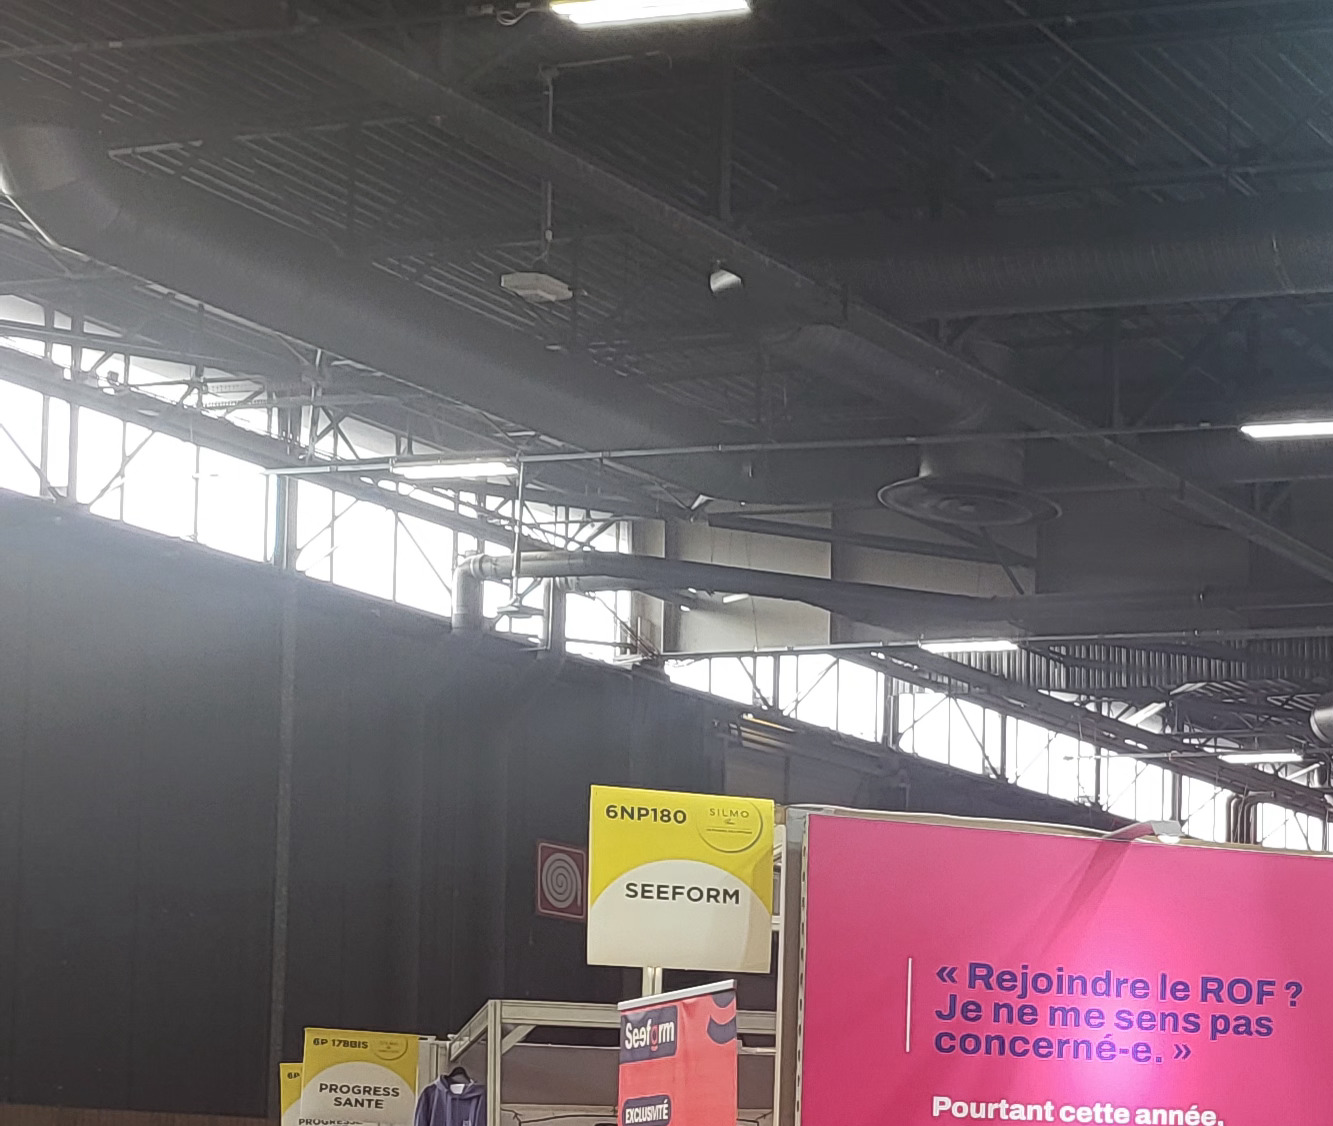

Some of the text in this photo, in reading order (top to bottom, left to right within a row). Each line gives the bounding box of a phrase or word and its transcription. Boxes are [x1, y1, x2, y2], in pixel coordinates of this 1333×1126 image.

[605, 804, 688, 824] 6NP180
[709, 807, 750, 818] SILMO
[625, 882, 740, 905] SEEFORM
[967, 960, 1150, 1001] Rejoindre
[1160, 973, 1190, 1001] le
[1200, 976, 1276, 1005] ROF
[935, 993, 1275, 1042] Je ne me sens pas
[933, 1028, 1164, 1064] concerné-e.
[319, 1082, 400, 1098] PROGRESS
[333, 1096, 384, 1109] SANTE
[625, 1100, 669, 1124] EXCLUSIVITÉ
[932, 1096, 1054, 1124] Pourtant
[1059, 1100, 1130, 1126] cette
